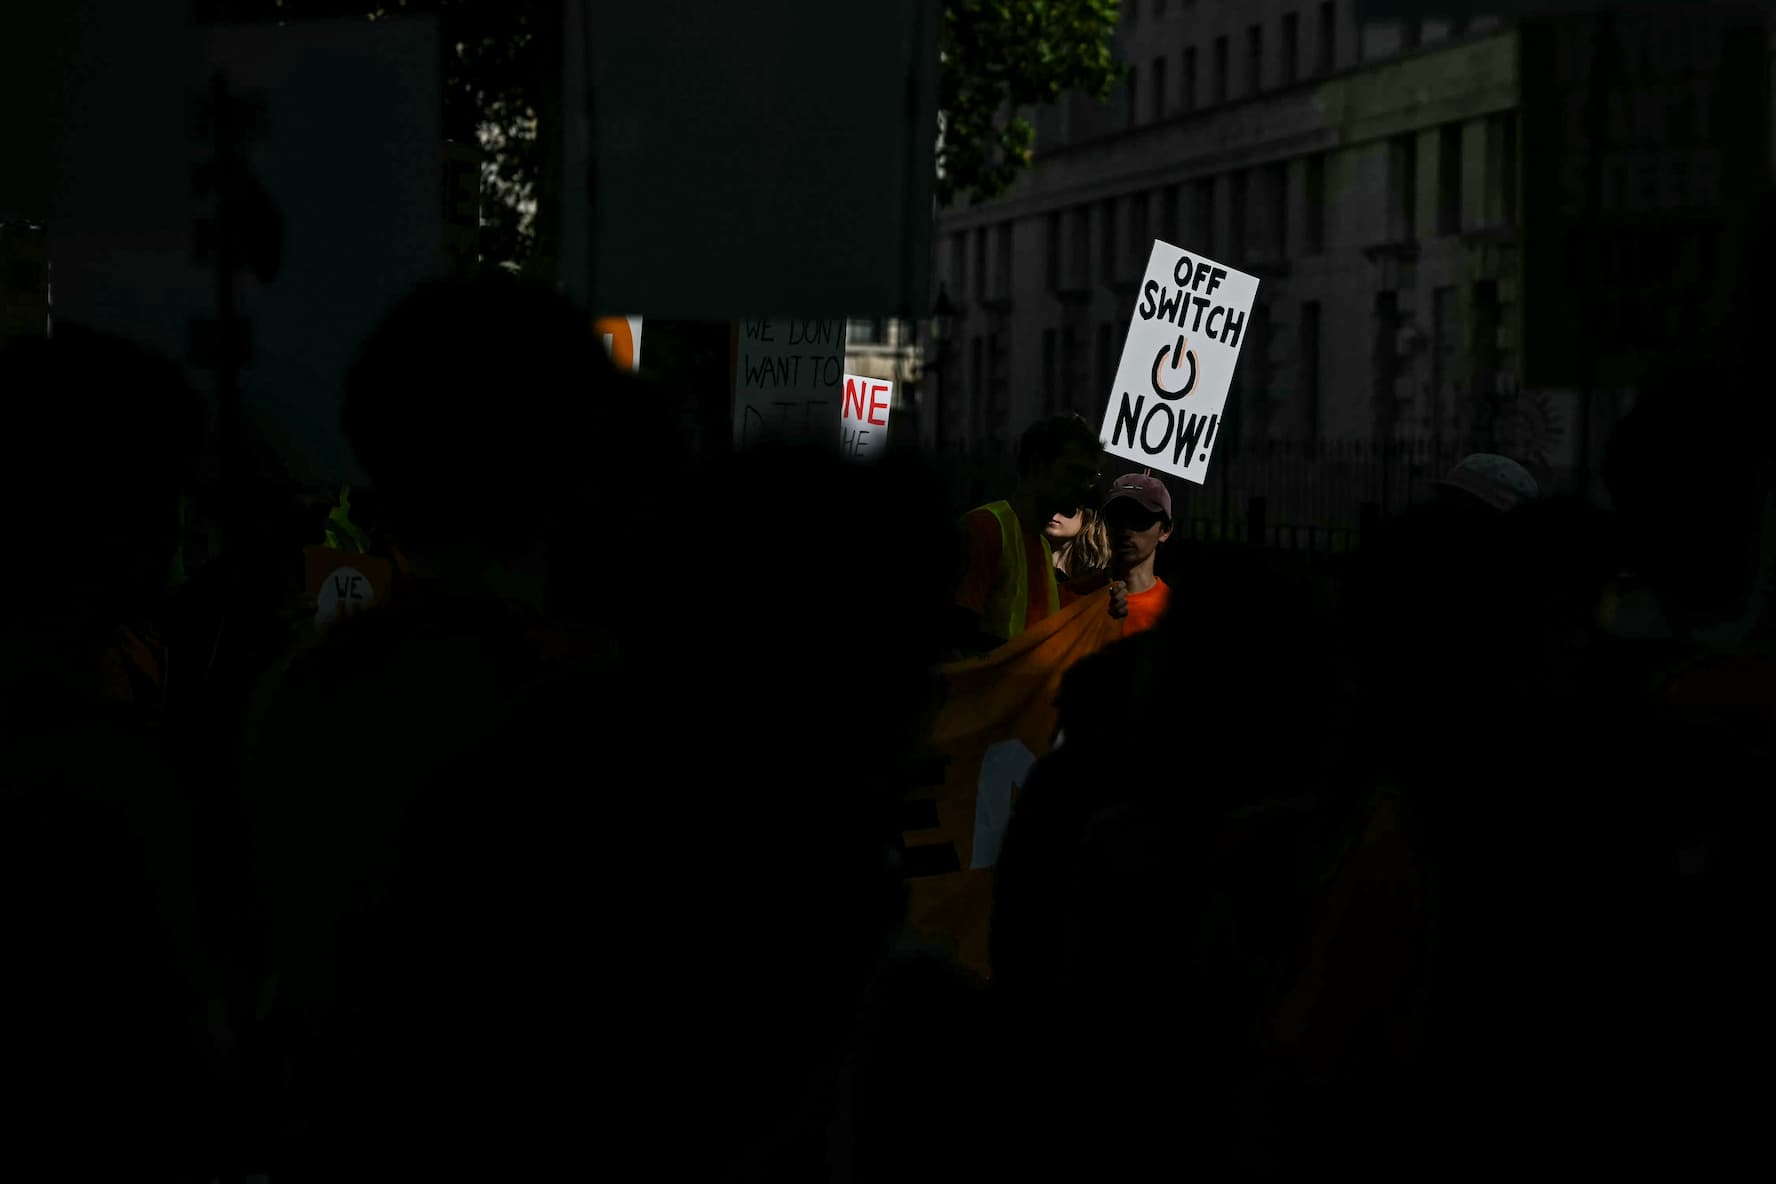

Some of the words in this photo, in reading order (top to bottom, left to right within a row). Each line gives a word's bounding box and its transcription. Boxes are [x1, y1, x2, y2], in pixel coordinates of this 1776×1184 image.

[1174, 257, 1227, 295] OFF
[745, 319, 774, 341] WE
[1139, 280, 1245, 347] SWITCH
[744, 354, 802, 389] WANT
[810, 355, 841, 389] TO
[1111, 392, 1218, 468] NOW!
[335, 576, 363, 599] WE
